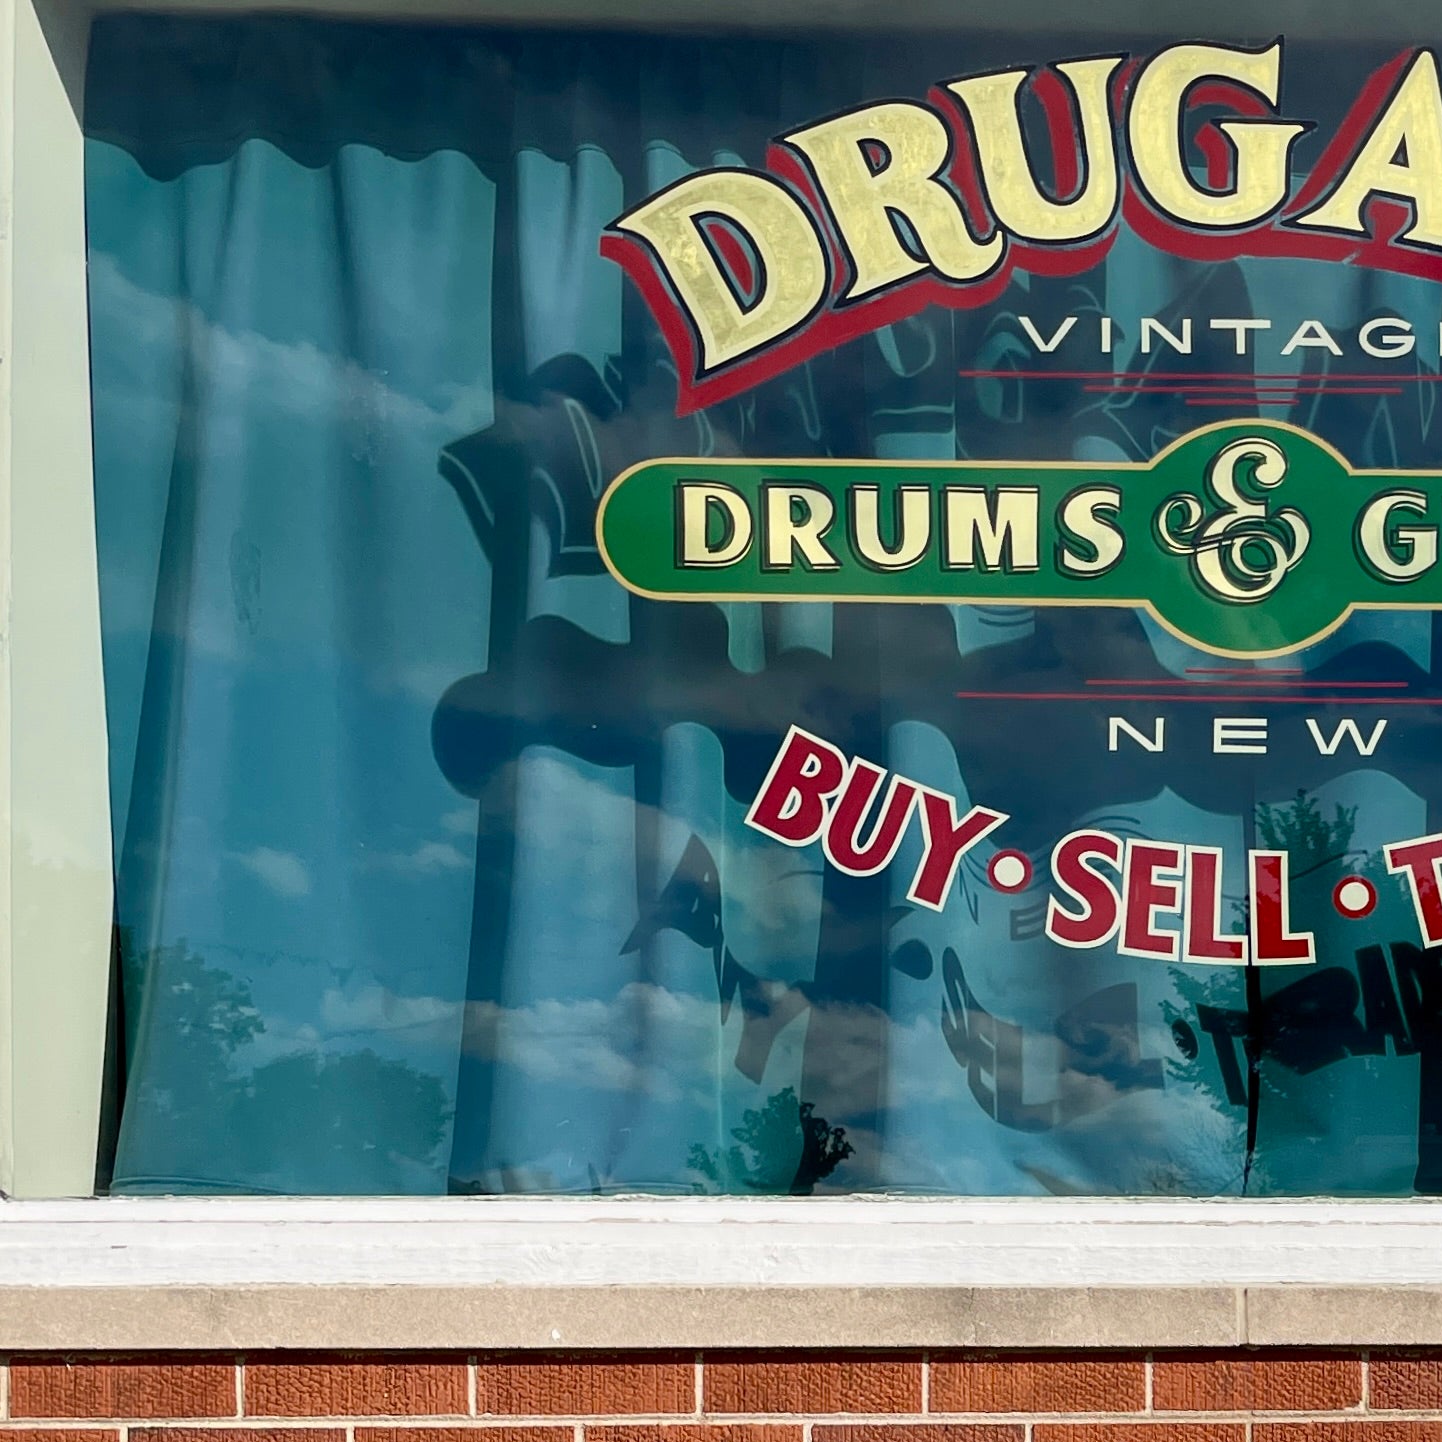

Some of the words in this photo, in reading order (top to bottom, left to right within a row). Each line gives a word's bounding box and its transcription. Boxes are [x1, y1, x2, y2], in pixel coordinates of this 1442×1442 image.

[675, 479, 1126, 578] DRUMS
[1152, 436, 1312, 604] &
[1108, 717, 1388, 756] NEW
[744, 724, 1010, 912] BUY
[1045, 829, 1316, 967] SELL
